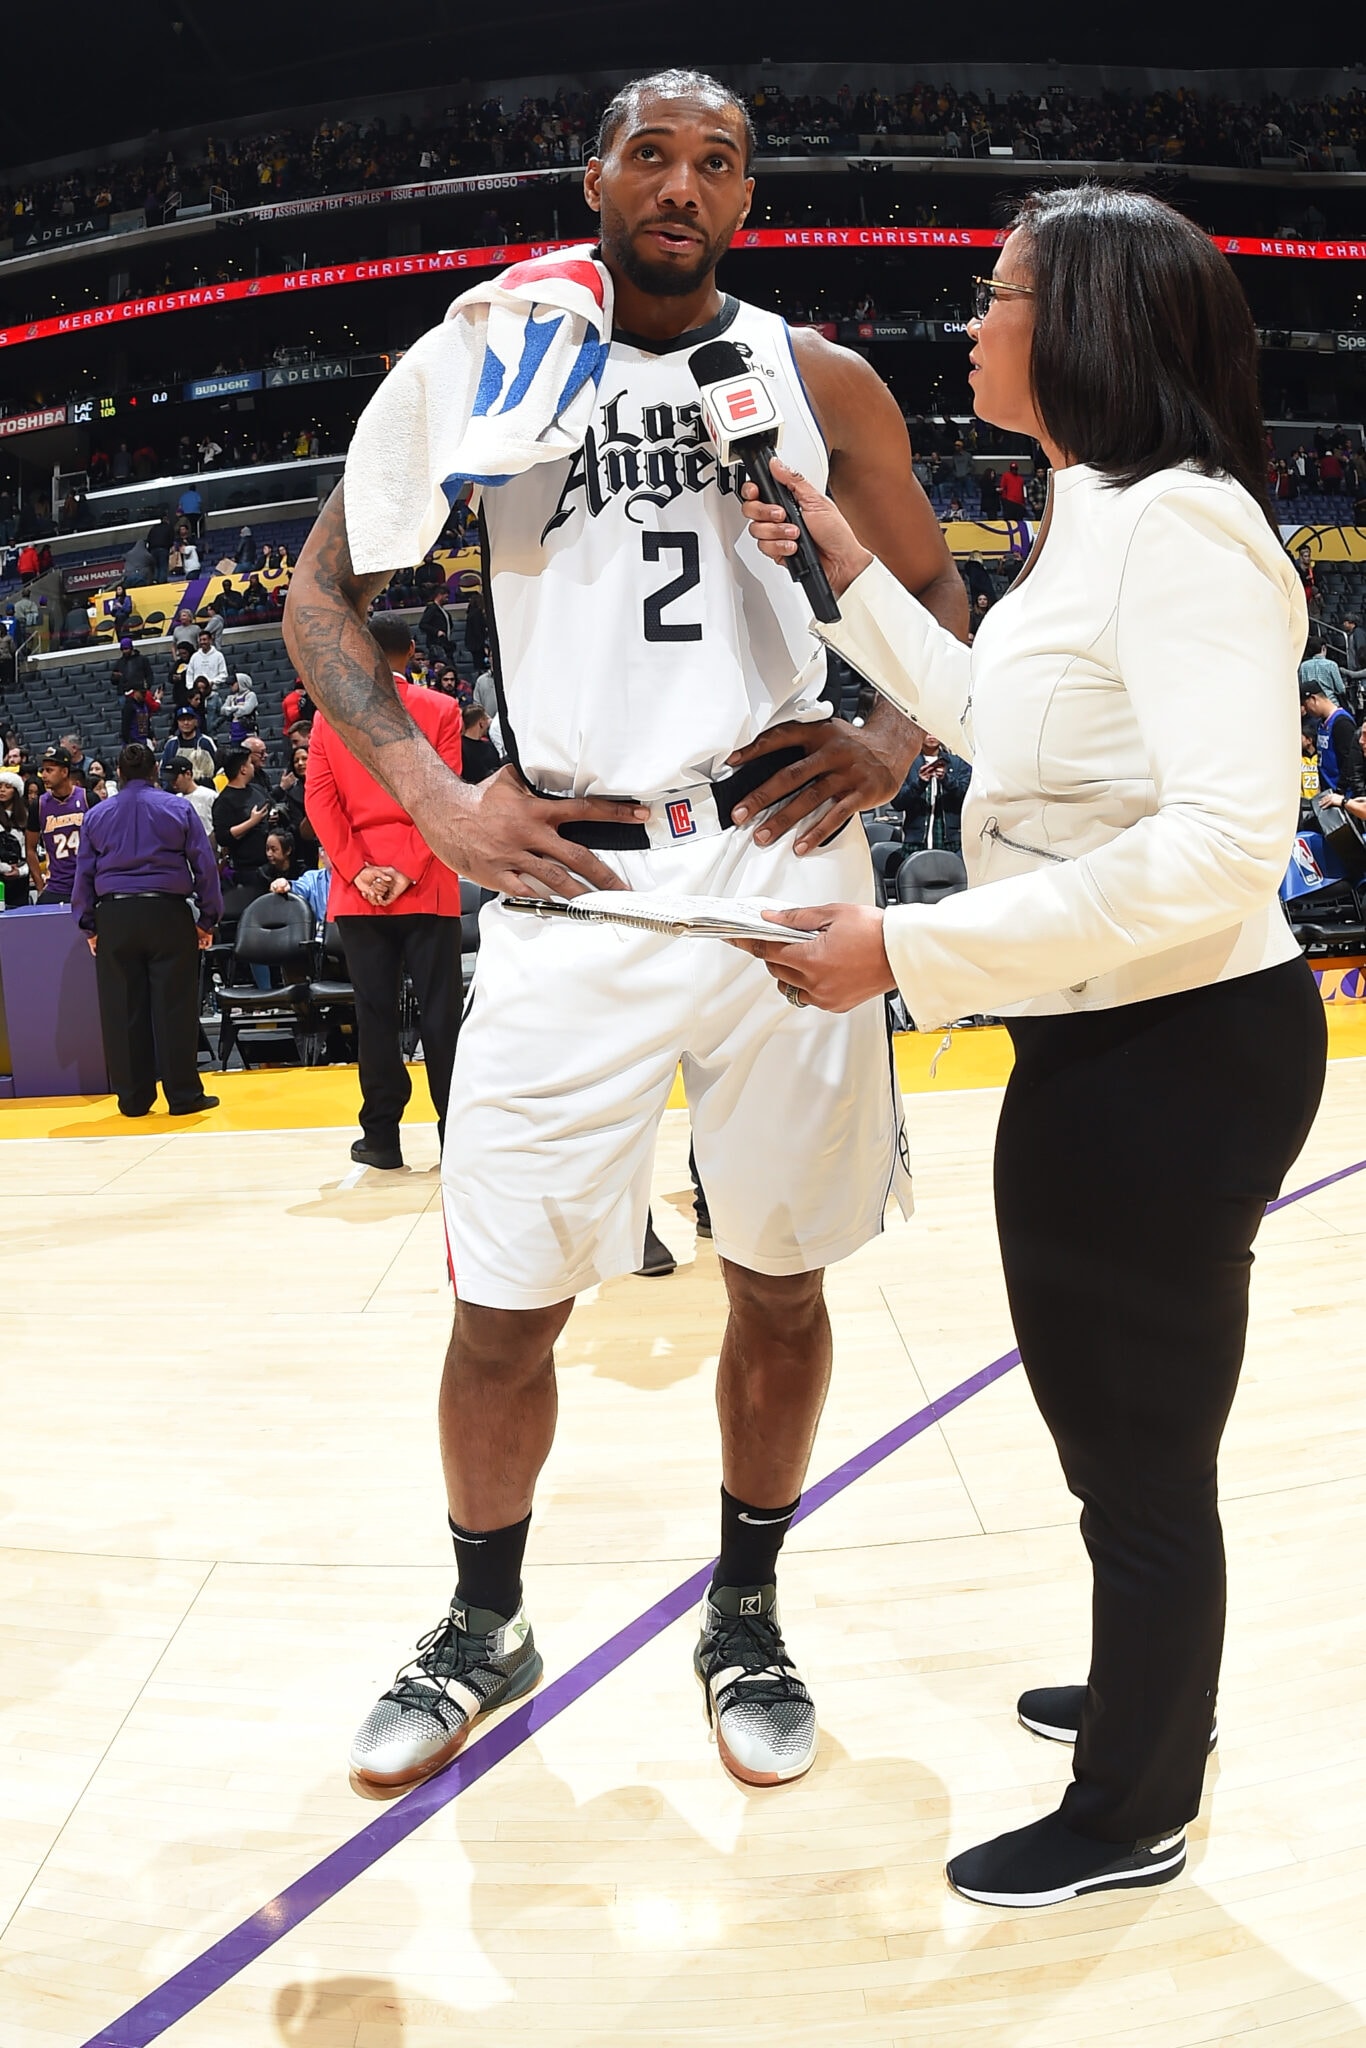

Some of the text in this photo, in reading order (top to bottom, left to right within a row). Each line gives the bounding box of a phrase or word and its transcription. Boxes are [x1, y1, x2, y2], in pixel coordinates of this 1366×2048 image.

[767, 134, 830, 147] Sperum
[275, 201, 323, 218] ASSISTANCE?
[325, 198, 344, 210] TEXT
[390, 189, 413, 200] ISSUE
[427, 181, 464, 196] LOCATION
[466, 181, 476, 192] TO
[477, 177, 518, 190] 69050
[42, 221, 94, 241] DELTA
[785, 231, 972, 244] MERRY CHRISTMAS
[1261, 242, 1366, 257] MERRY CHRI
[284, 253, 468, 288] MERRY CHRISTMAS
[59, 288, 225, 330] MERRY CHRISTMAS
[875, 327, 908, 336] TOYOTA
[288, 364, 343, 382] DELTA
[195, 379, 249, 396] BUD LIGHT
[152, 392, 168, 403] 0.0
[75, 402, 94, 414] LAC
[0, 410, 65, 435] TOSHIBA
[74, 412, 92, 423] LAL
[599, 389, 712, 449] Los
[73, 569, 122, 583] SAN MANUEL
[642, 530, 703, 642] 2
[1303, 775, 1320, 790] 23
[53, 831, 80, 859] 24
